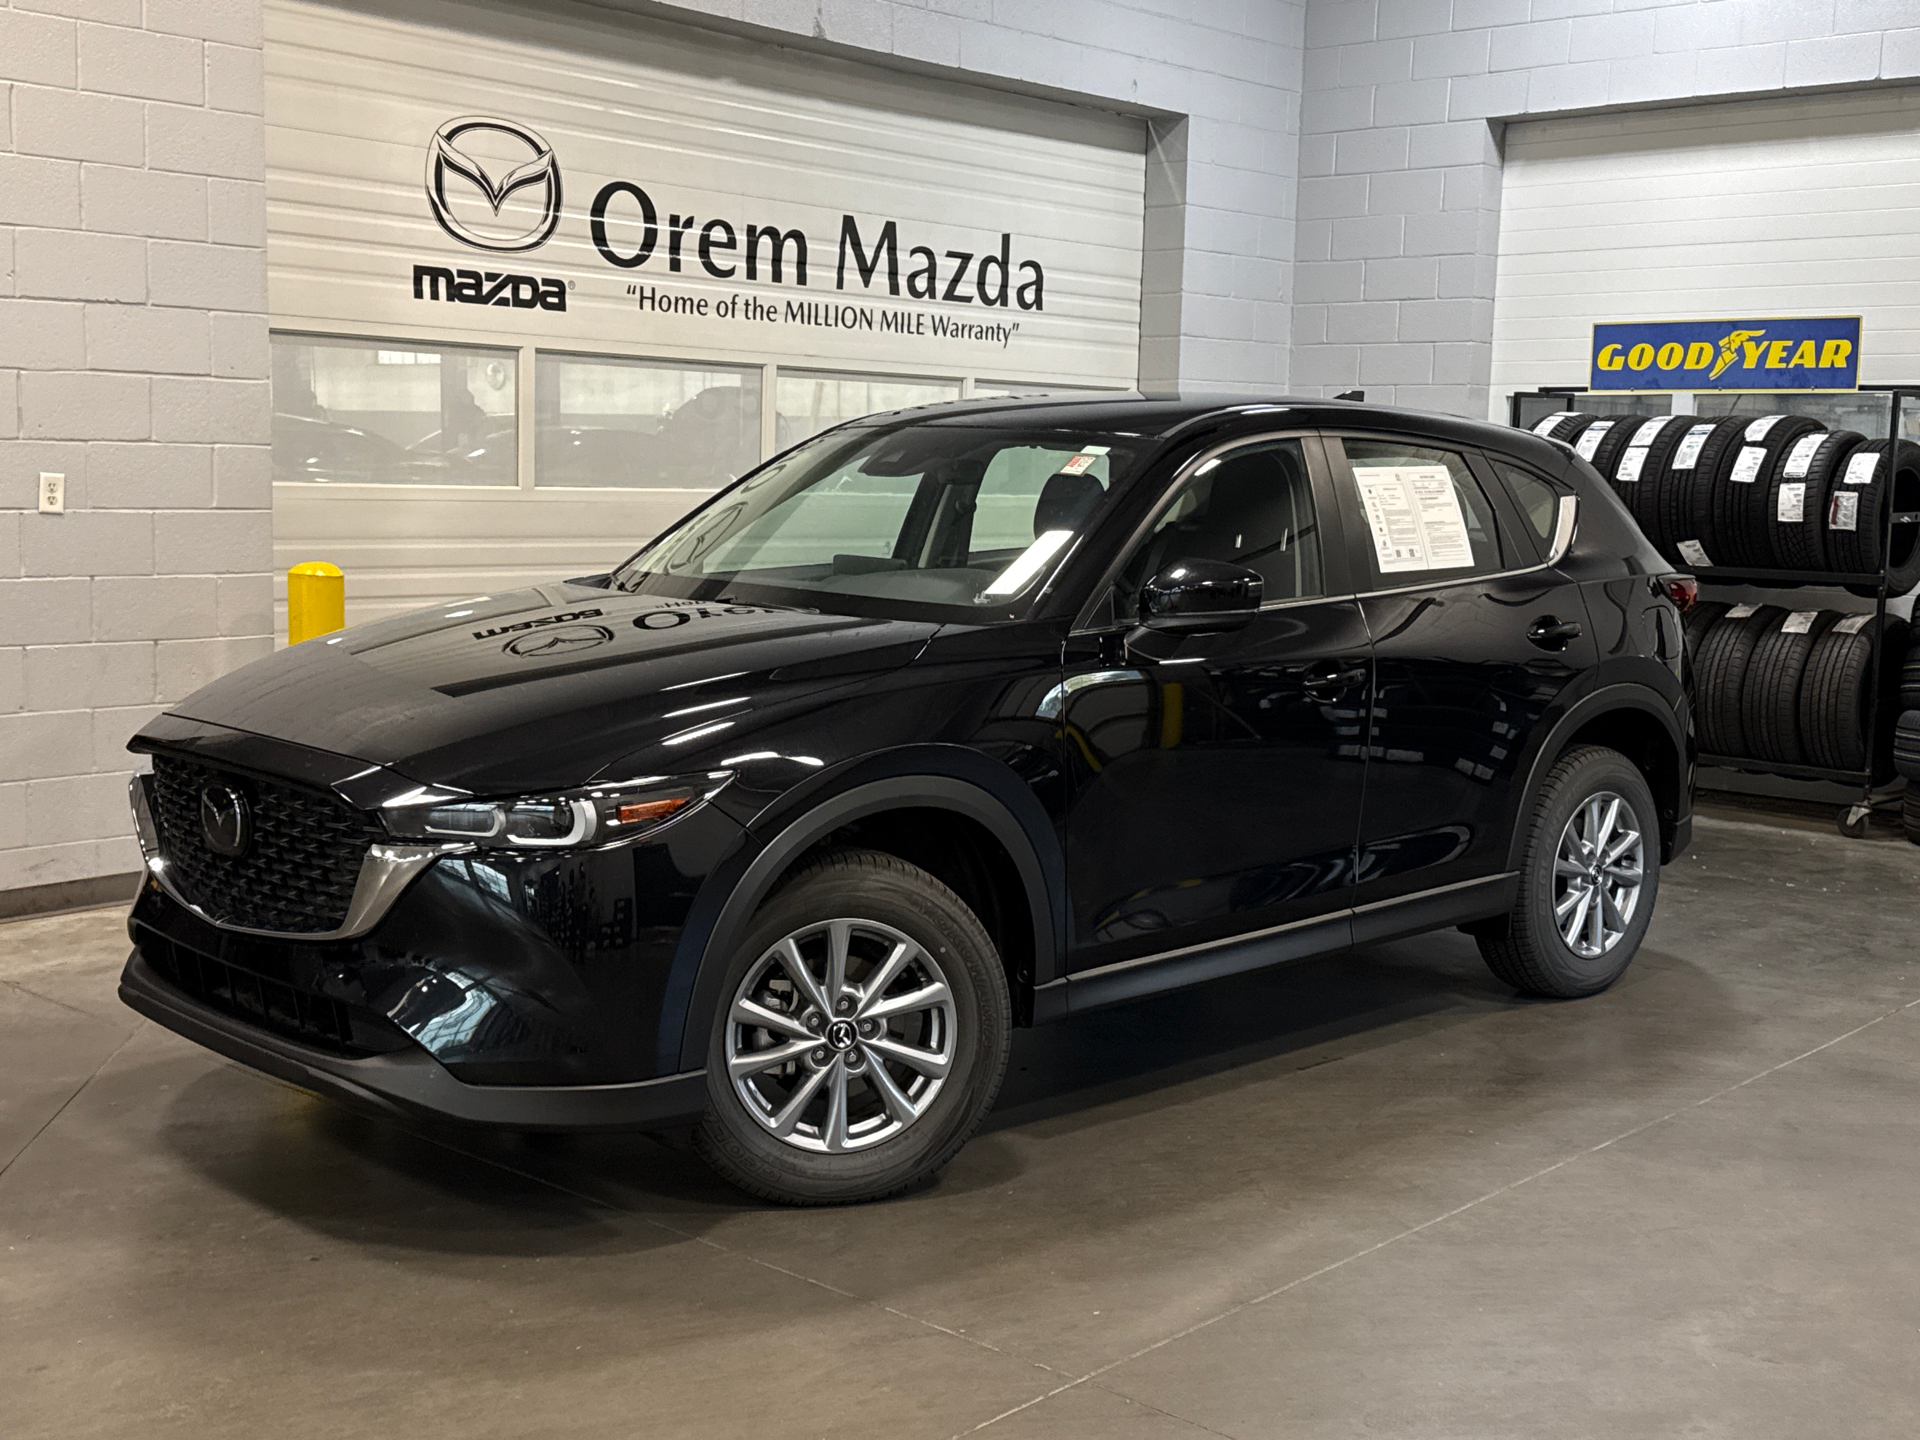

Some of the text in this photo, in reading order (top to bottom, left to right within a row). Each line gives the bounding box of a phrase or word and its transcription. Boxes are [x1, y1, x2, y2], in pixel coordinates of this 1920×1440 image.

[589, 180, 1045, 312] Orem Mazda
[716, 293, 739, 319] of
[743, 296, 778, 322] the
[784, 300, 873, 330] MILLION
[880, 310, 926, 335] MILE
